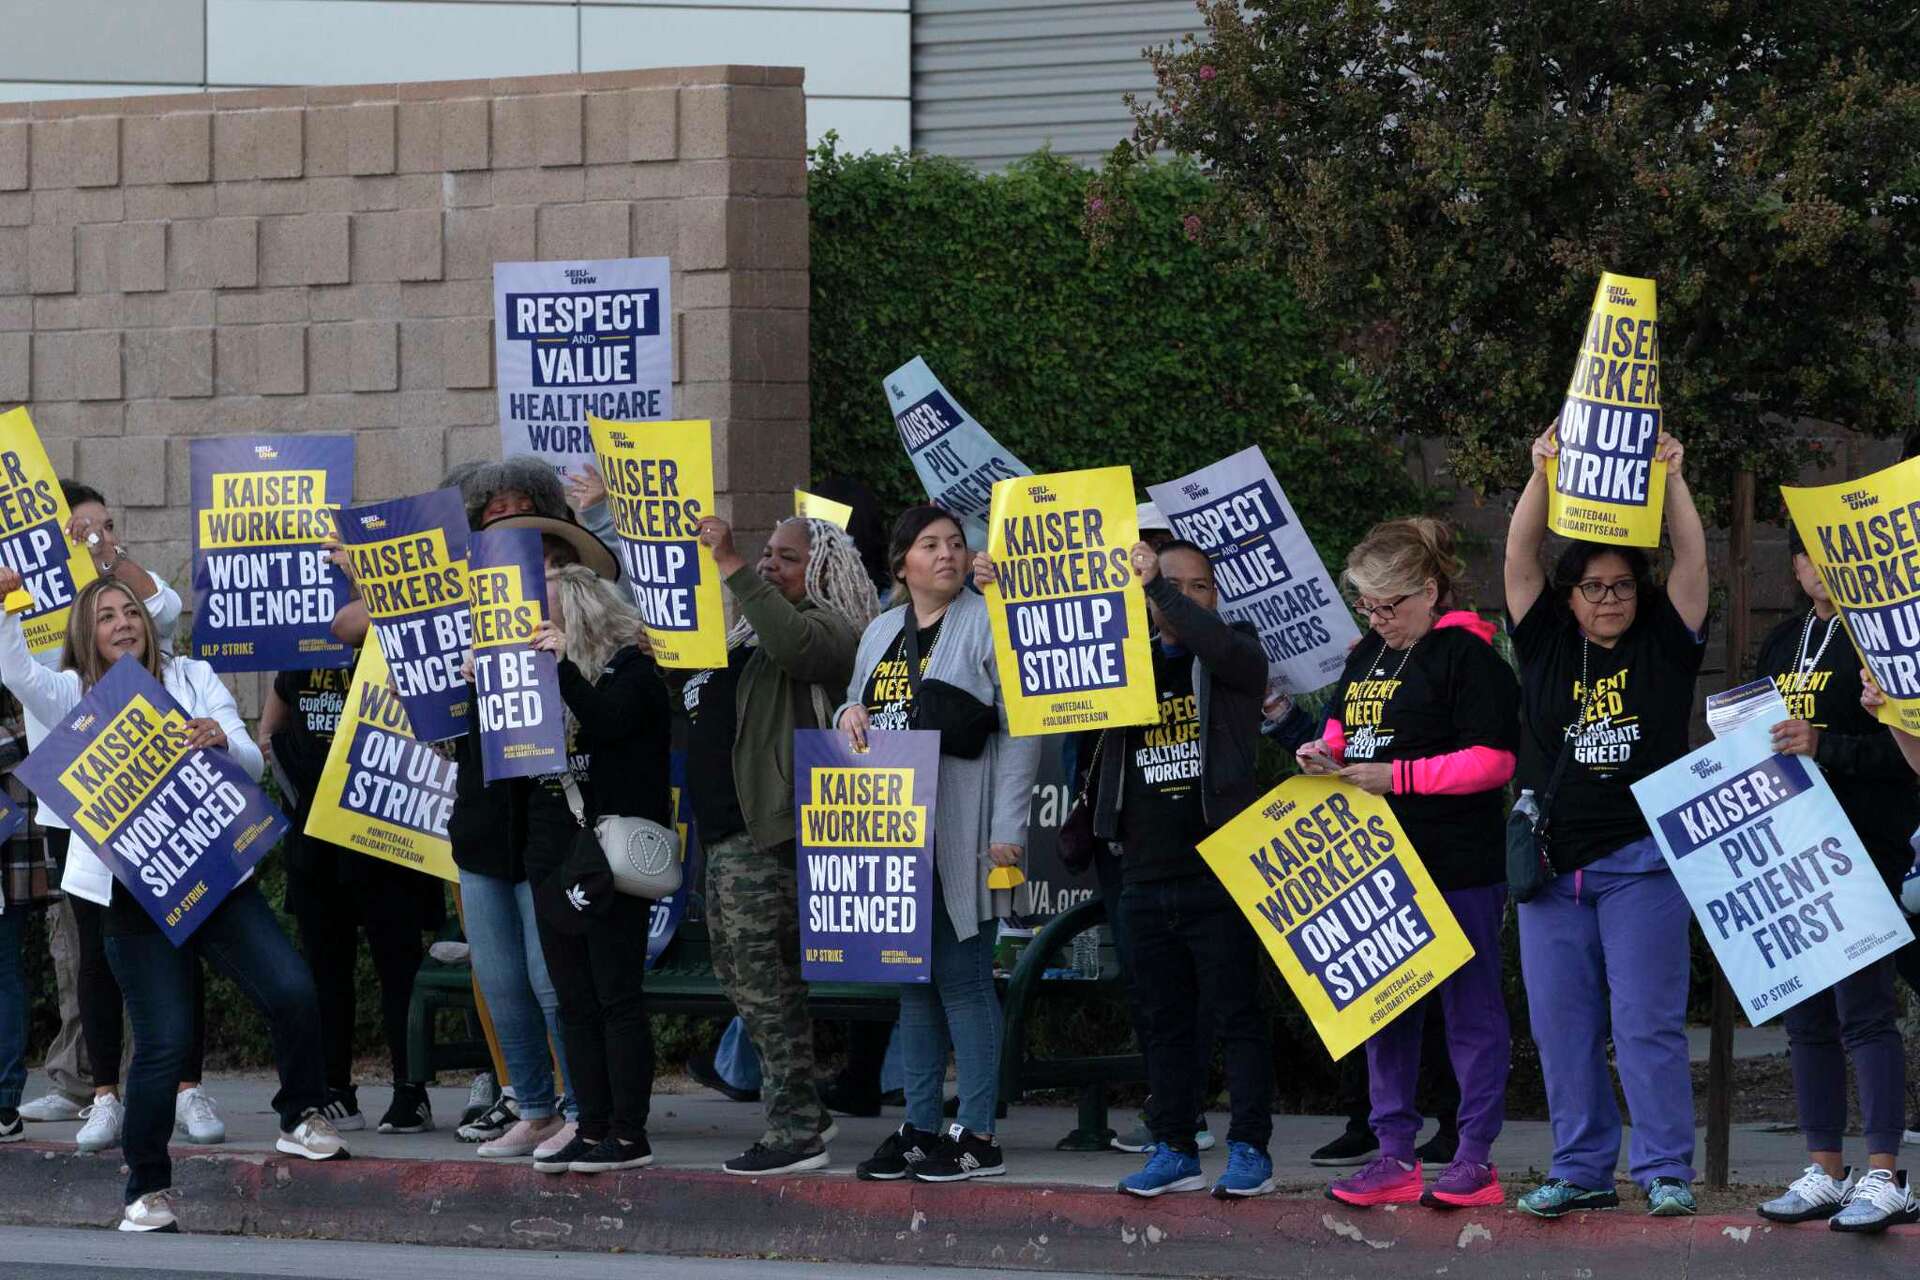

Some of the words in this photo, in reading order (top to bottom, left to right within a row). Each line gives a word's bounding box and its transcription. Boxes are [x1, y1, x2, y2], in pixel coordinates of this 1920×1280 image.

[516, 293, 650, 333] RESPECT
[1608, 295, 1637, 307] UHW
[572, 334, 596, 345] AND
[537, 345, 631, 384] VALUE
[1572, 353, 1662, 405] ORKER
[509, 389, 661, 422] HEALTHCARE
[527, 424, 596, 453] WORK
[1560, 400, 1592, 448] ON
[1596, 408, 1654, 455] ULP
[923, 439, 969, 484] PUT
[1557, 446, 1648, 501] STRIKE
[223, 476, 314, 508] KAISER
[934, 457, 1019, 517] ATIENTS
[1027, 485, 1050, 496] SEIU-
[1033, 493, 1057, 503] UHW
[1841, 490, 1870, 505] SEIU-
[1850, 495, 1879, 511] UHW
[208, 508, 331, 543] WORKERS
[609, 494, 702, 537] ORKERS
[1004, 508, 1105, 557] KAISER
[1174, 487, 1273, 551] RESPECT
[1565, 505, 1617, 524] #UNITED4ALL
[207, 551, 292, 590] WON'T
[299, 550, 333, 586] BE
[347, 538, 438, 580] KAISER
[634, 543, 686, 584] ULP
[1222, 544, 1239, 557] AND
[360, 567, 464, 614] ORKERS
[470, 573, 510, 608] SER
[993, 547, 1130, 600] WORKERS
[1213, 544, 1285, 601] VALUE
[1819, 550, 1920, 604] WORKE
[209, 588, 335, 628] SILENCED
[473, 605, 534, 643] KERS
[1016, 603, 1050, 647] ON
[1054, 598, 1112, 644] ULP
[201, 644, 219, 656] ULP
[222, 642, 254, 655] STRIKE
[432, 609, 472, 652] BE
[1260, 615, 1332, 664] ORKERS
[1849, 610, 1890, 651] ON
[391, 649, 472, 698] ENCE
[500, 650, 540, 689] BE
[1022, 643, 1120, 692] STRIKE
[299, 697, 343, 713] CORPOR
[1050, 700, 1094, 713] #UNITED4ALL
[1344, 679, 1402, 701] PATIENT
[1582, 690, 1624, 724] EED
[1784, 694, 1816, 721] EED
[307, 713, 341, 732] GREE
[478, 690, 543, 734] NCED
[1042, 711, 1109, 727] #SOLIDARITYSEASON
[1345, 701, 1384, 726] NEED
[72, 707, 155, 795] KAISER
[1136, 740, 1201, 768] HEALTHCA
[1144, 722, 1200, 747] VALUE
[1575, 723, 1641, 747] ORPORATE
[1575, 744, 1631, 764] GREED
[83, 720, 189, 832] WORKERS
[360, 730, 406, 776] ON
[406, 742, 459, 793] ULP
[1690, 757, 1713, 775] SEIU-
[1699, 761, 1723, 780] UHW
[348, 770, 456, 836] STRIKE
[820, 773, 903, 805] KAISER
[1679, 770, 1788, 845] KAISER:
[112, 781, 190, 867] WON'T
[177, 751, 223, 800] BE
[807, 809, 917, 843] WORKERS
[1262, 800, 1285, 819] SEIU-
[1272, 801, 1297, 821] UHW
[141, 781, 247, 897] SILENCED
[350, 834, 425, 864] #SOLIDARITYSEASON
[366, 826, 415, 849] #UNITED4ALL
[1249, 793, 1359, 889] KAISER
[1720, 815, 1785, 879] PUT
[807, 855, 880, 892] WON'T
[886, 856, 917, 892] BE
[1256, 815, 1396, 934] WORKERS
[1706, 836, 1853, 940] PATIENTS
[166, 907, 182, 926] ULP
[181, 883, 209, 912] STRIKE
[809, 895, 917, 933] SILENCED
[1301, 908, 1351, 964] ON
[1340, 868, 1397, 932] ULP
[1752, 891, 1845, 969] FIRST
[805, 949, 818, 962] ULP
[819, 949, 844, 963] STRIKE
[1325, 905, 1428, 1001] STRIKE
[1369, 970, 1435, 1025] #SOLIDARITYSEASON
[1373, 969, 1418, 1006] #UNITED4ALL
[1750, 993, 1771, 1012] ULP
[1770, 976, 1804, 1002] STRIKE
